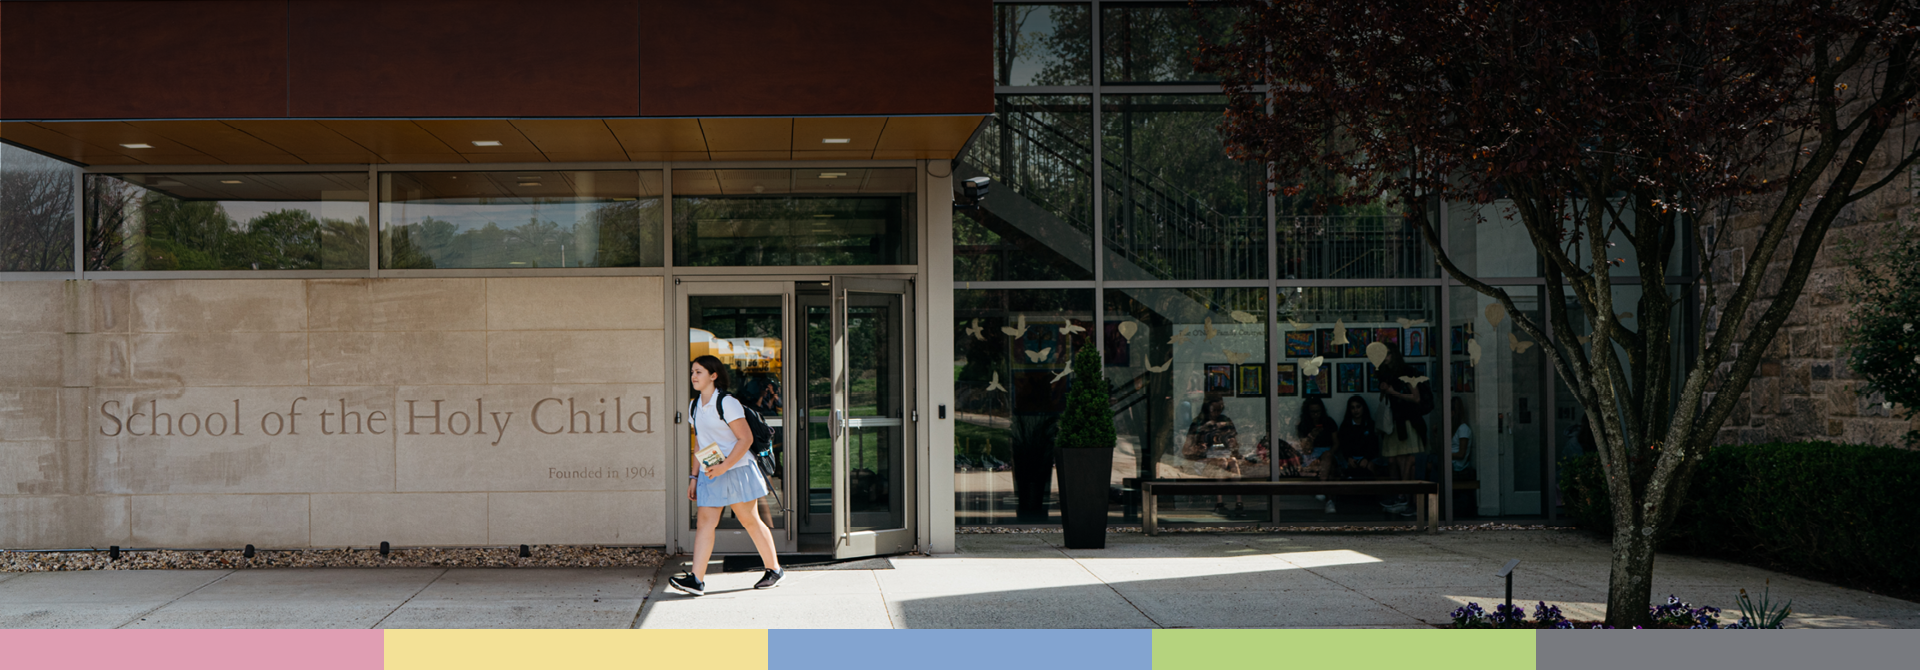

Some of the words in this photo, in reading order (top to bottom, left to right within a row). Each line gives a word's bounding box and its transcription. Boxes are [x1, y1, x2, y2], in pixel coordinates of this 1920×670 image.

[100, 399, 244, 437] School
[261, 396, 307, 437] of
[319, 398, 386, 435] the
[404, 398, 513, 446] Holy
[530, 396, 655, 434] Child
[548, 467, 602, 480] Founded
[607, 467, 619, 479] in
[625, 465, 655, 479] 1904
